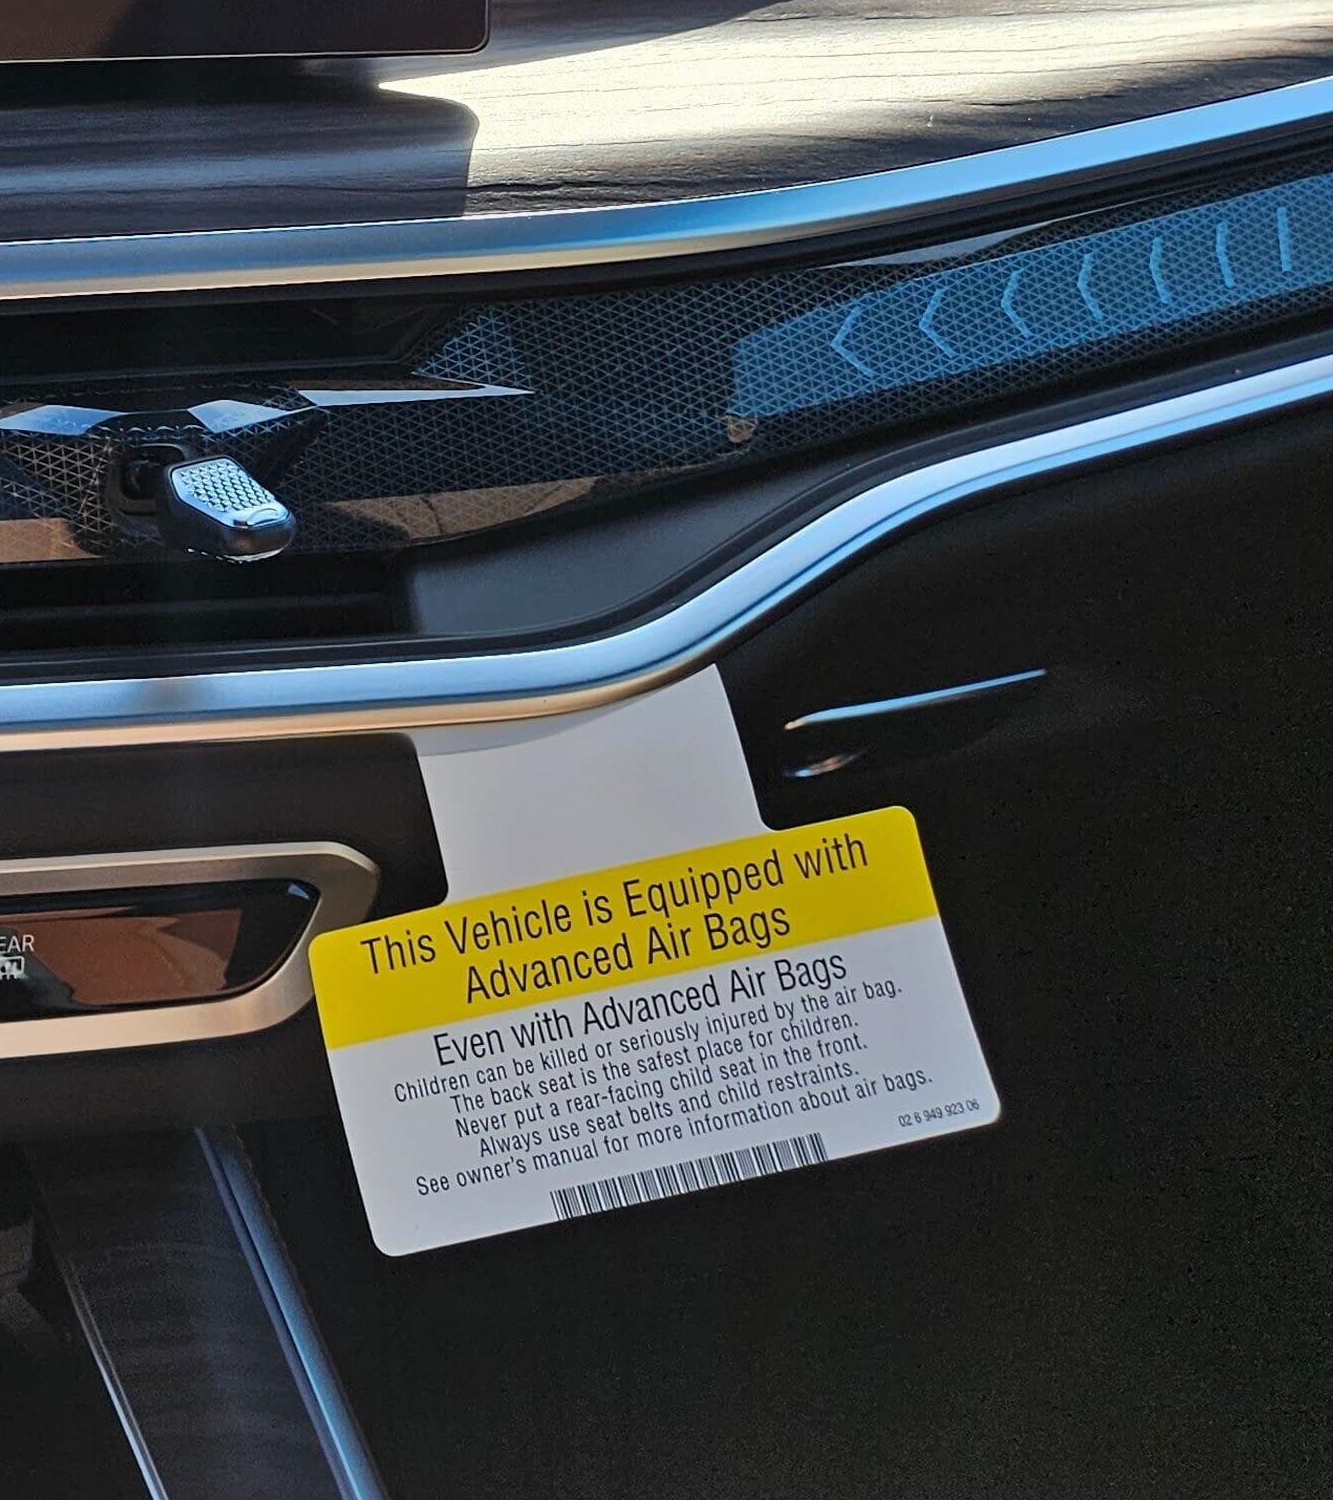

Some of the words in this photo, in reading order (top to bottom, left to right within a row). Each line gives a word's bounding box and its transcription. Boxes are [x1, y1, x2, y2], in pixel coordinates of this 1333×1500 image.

[360, 930, 436, 974] This
[444, 899, 572, 955] Vehicle
[582, 890, 613, 926] is
[623, 849, 784, 918] Equipped
[794, 833, 868, 879] with
[467, 933, 633, 1004] Advanced
[647, 922, 692, 964] Air
[704, 907, 790, 950] Bags
[394, 1073, 470, 1102] Children
[476, 1064, 508, 1085] can
[513, 1058, 535, 1077] be
[540, 1045, 588, 1071] killed
[595, 1041, 613, 1059] or
[620, 1021, 701, 1053] seriously
[705, 1005, 769, 1037] injured
[774, 998, 794, 1022] by
[801, 993, 829, 1013] the
[835, 986, 857, 1006] air
[862, 978, 902, 999] bag.
[433, 1028, 504, 1066] Even
[511, 1009, 573, 1049] with
[583, 974, 721, 1034] Advanced
[730, 966, 767, 1002] Air
[775, 954, 847, 991] Bags
[450, 1092, 485, 1114] The
[490, 1081, 535, 1106] back
[539, 1071, 577, 1095] seat
[581, 1066, 597, 1086] is
[602, 1060, 631, 1081] the
[637, 1046, 692, 1074] safest
[697, 1035, 743, 1064] place
[748, 1028, 774, 1048] for
[781, 1012, 859, 1043] children.
[416, 1175, 450, 1196] See
[456, 1156, 527, 1188] owner's
[532, 1137, 599, 1171] manual
[603, 1134, 629, 1155] for
[636, 1123, 683, 1150] more
[687, 1100, 793, 1136] information
[800, 1087, 851, 1112] about
[855, 1078, 878, 1099] air
[882, 1068, 933, 1092] bags.
[455, 1113, 507, 1138] Never
[514, 1104, 545, 1130] put
[550, 1102, 560, 1117] a
[566, 1077, 664, 1113] rear-facing
[670, 1065, 713, 1091] child
[719, 1056, 757, 1081] seat
[763, 1050, 779, 1072] in
[784, 1045, 813, 1066] the
[817, 1033, 868, 1058] front.
[479, 1128, 542, 1158] Always
[548, 1122, 580, 1143] use
[586, 1110, 624, 1134] seat
[629, 1100, 673, 1125] belts
[679, 1091, 712, 1113] and
[718, 1079, 761, 1105] child
[767, 1059, 859, 1093] restraints.
